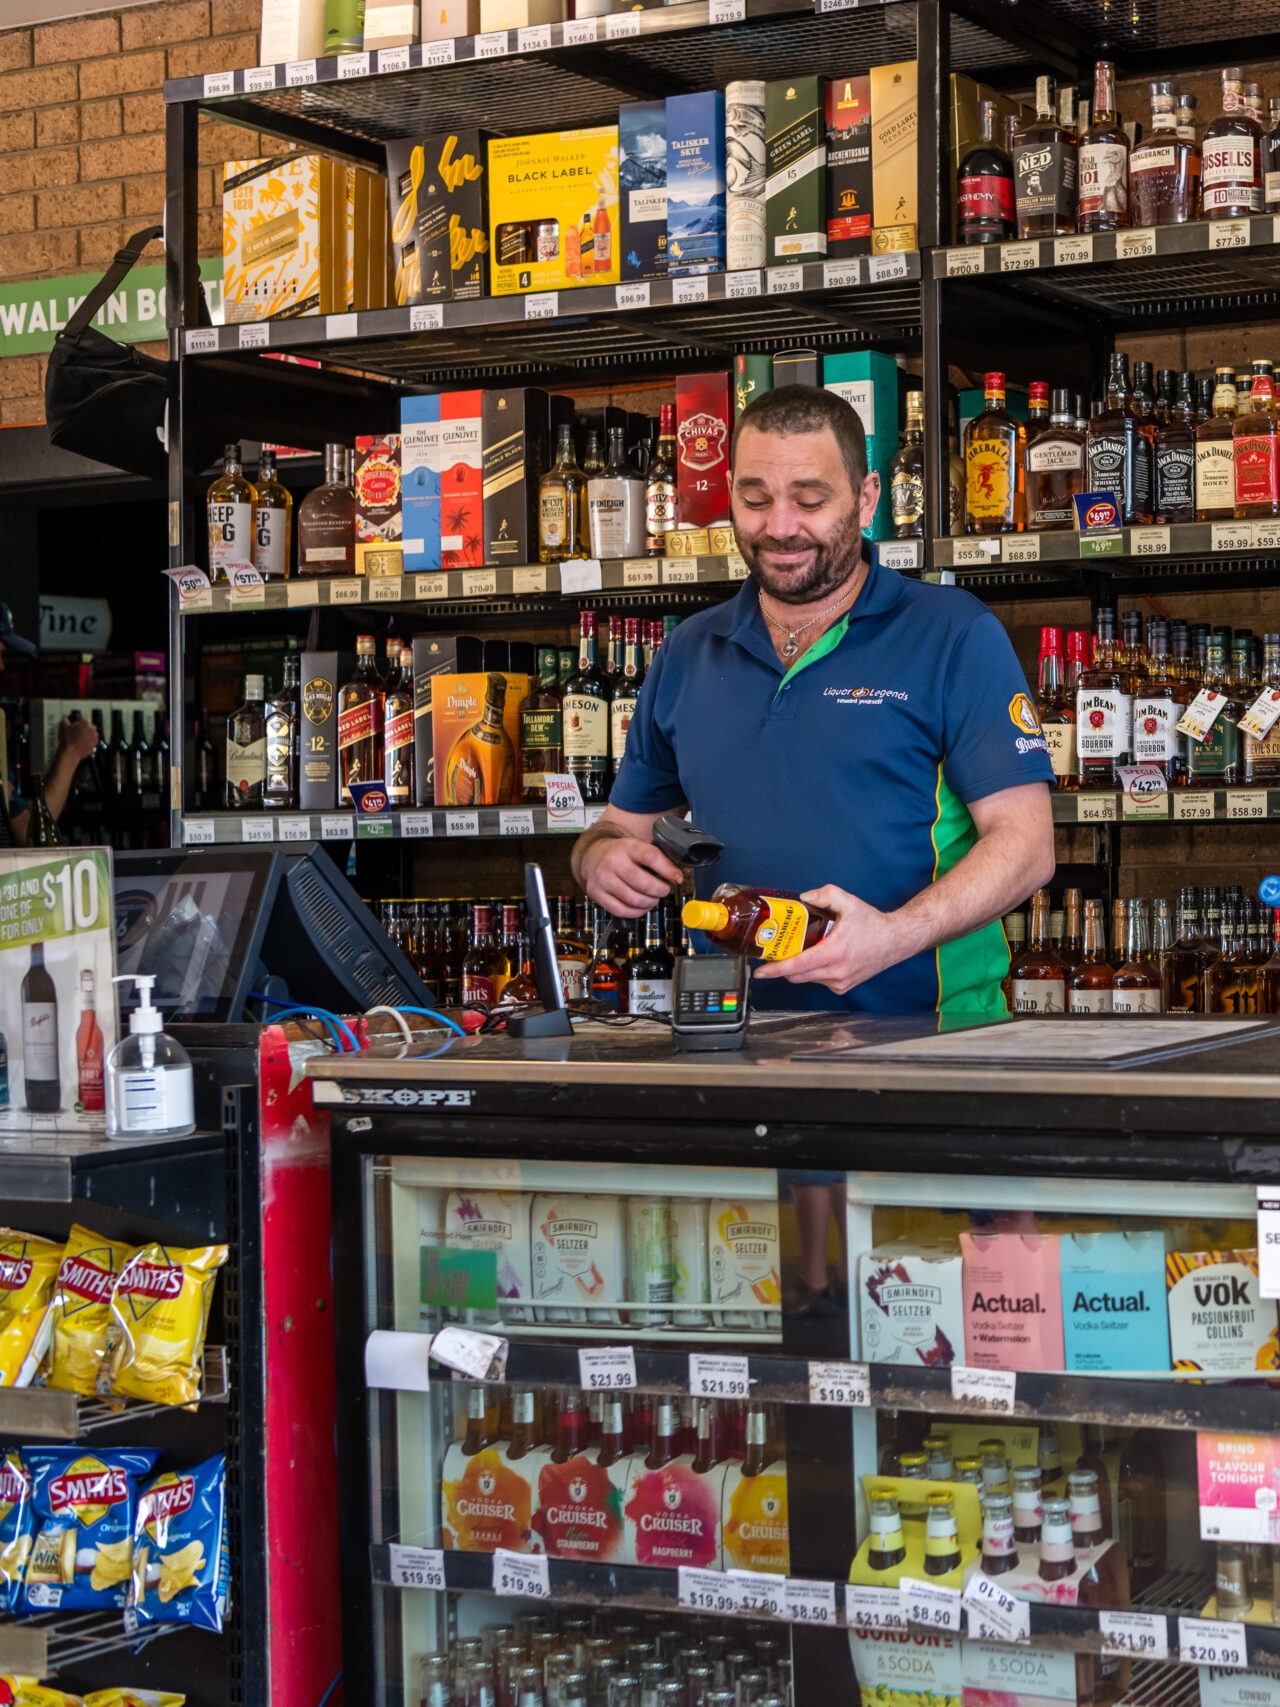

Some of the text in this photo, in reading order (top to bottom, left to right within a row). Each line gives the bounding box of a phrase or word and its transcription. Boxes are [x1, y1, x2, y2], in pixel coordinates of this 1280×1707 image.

[568, 32, 595, 43] $146.0
[290, 74, 314, 85] $99.99
[208, 83, 230, 93] $96.99
[671, 138, 709, 149] TALISKER
[770, 127, 814, 158] GREEN LABEL
[680, 147, 700, 156] SKYE
[1131, 149, 1170, 162] LONGBRANCH
[1020, 153, 1051, 172] NED
[507, 166, 592, 183] BLACK LABEL
[787, 169, 796, 179] 15
[1080, 173, 1099, 186] 101
[1216, 236, 1246, 247] $77.99
[876, 268, 904, 280] $88.99
[97, 291, 127, 325] IN
[527, 308, 554, 319] $34.99
[191, 340, 215, 349] $111.99
[685, 426, 719, 437] CHIVAS
[404, 435, 439, 445] GLENLIVET
[968, 443, 1010, 462] FIREBALL
[1034, 450, 1077, 459] GENTLEMAN
[1047, 456, 1064, 464] JACK
[696, 480, 708, 490] 12
[1137, 543, 1167, 553] $58.99
[823, 687, 908, 701] Liquor Legends
[447, 696, 477, 709] Dimple
[1079, 697, 1116, 713] JIM BEAM
[523, 713, 554, 724] TULLAMORE
[1082, 740, 1113, 749] BOURBON
[547, 782, 575, 790] SPECIAL
[20, 858, 99, 932] AND $10
[1, 916, 44, 940] FOR ONLY
[768, 906, 794, 961] BUNDABERG
[782, 916, 802, 956] ORIGINAL
[341, 1088, 471, 1106] SKOPE
[556, 1238, 589, 1251] SELTZER
[735, 1243, 768, 1254] SELTZER
[57, 1258, 116, 1299] SMITH'S
[118, 1260, 182, 1293] SMITH'S
[1193, 1276, 1250, 1307] vok
[971, 1292, 1047, 1315] Actual.
[1073, 1291, 1151, 1314] Actual.
[1191, 1309, 1255, 1326] PASSIONFRUIT
[979, 1332, 1031, 1344] Watermelon
[1206, 1325, 1243, 1340] COLLINS
[701, 1379, 745, 1394] $21.99
[1218, 1442, 1255, 1454] BRING
[1209, 1461, 1266, 1474] FLAVOUR
[1211, 1472, 1265, 1485] TONIGHT
[50, 1470, 128, 1504] SMITH'S
[457, 1500, 515, 1521] CRUISER
[547, 1508, 608, 1529] CRUISER
[640, 1514, 702, 1536] CRUISER
[556, 1537, 599, 1552] STRAWBERRY
[652, 1546, 693, 1559] RASPBERRY
[791, 1603, 828, 1620] $8.50
[1189, 1646, 1240, 1664] $20.99
[890, 1656, 936, 1675] SODA
